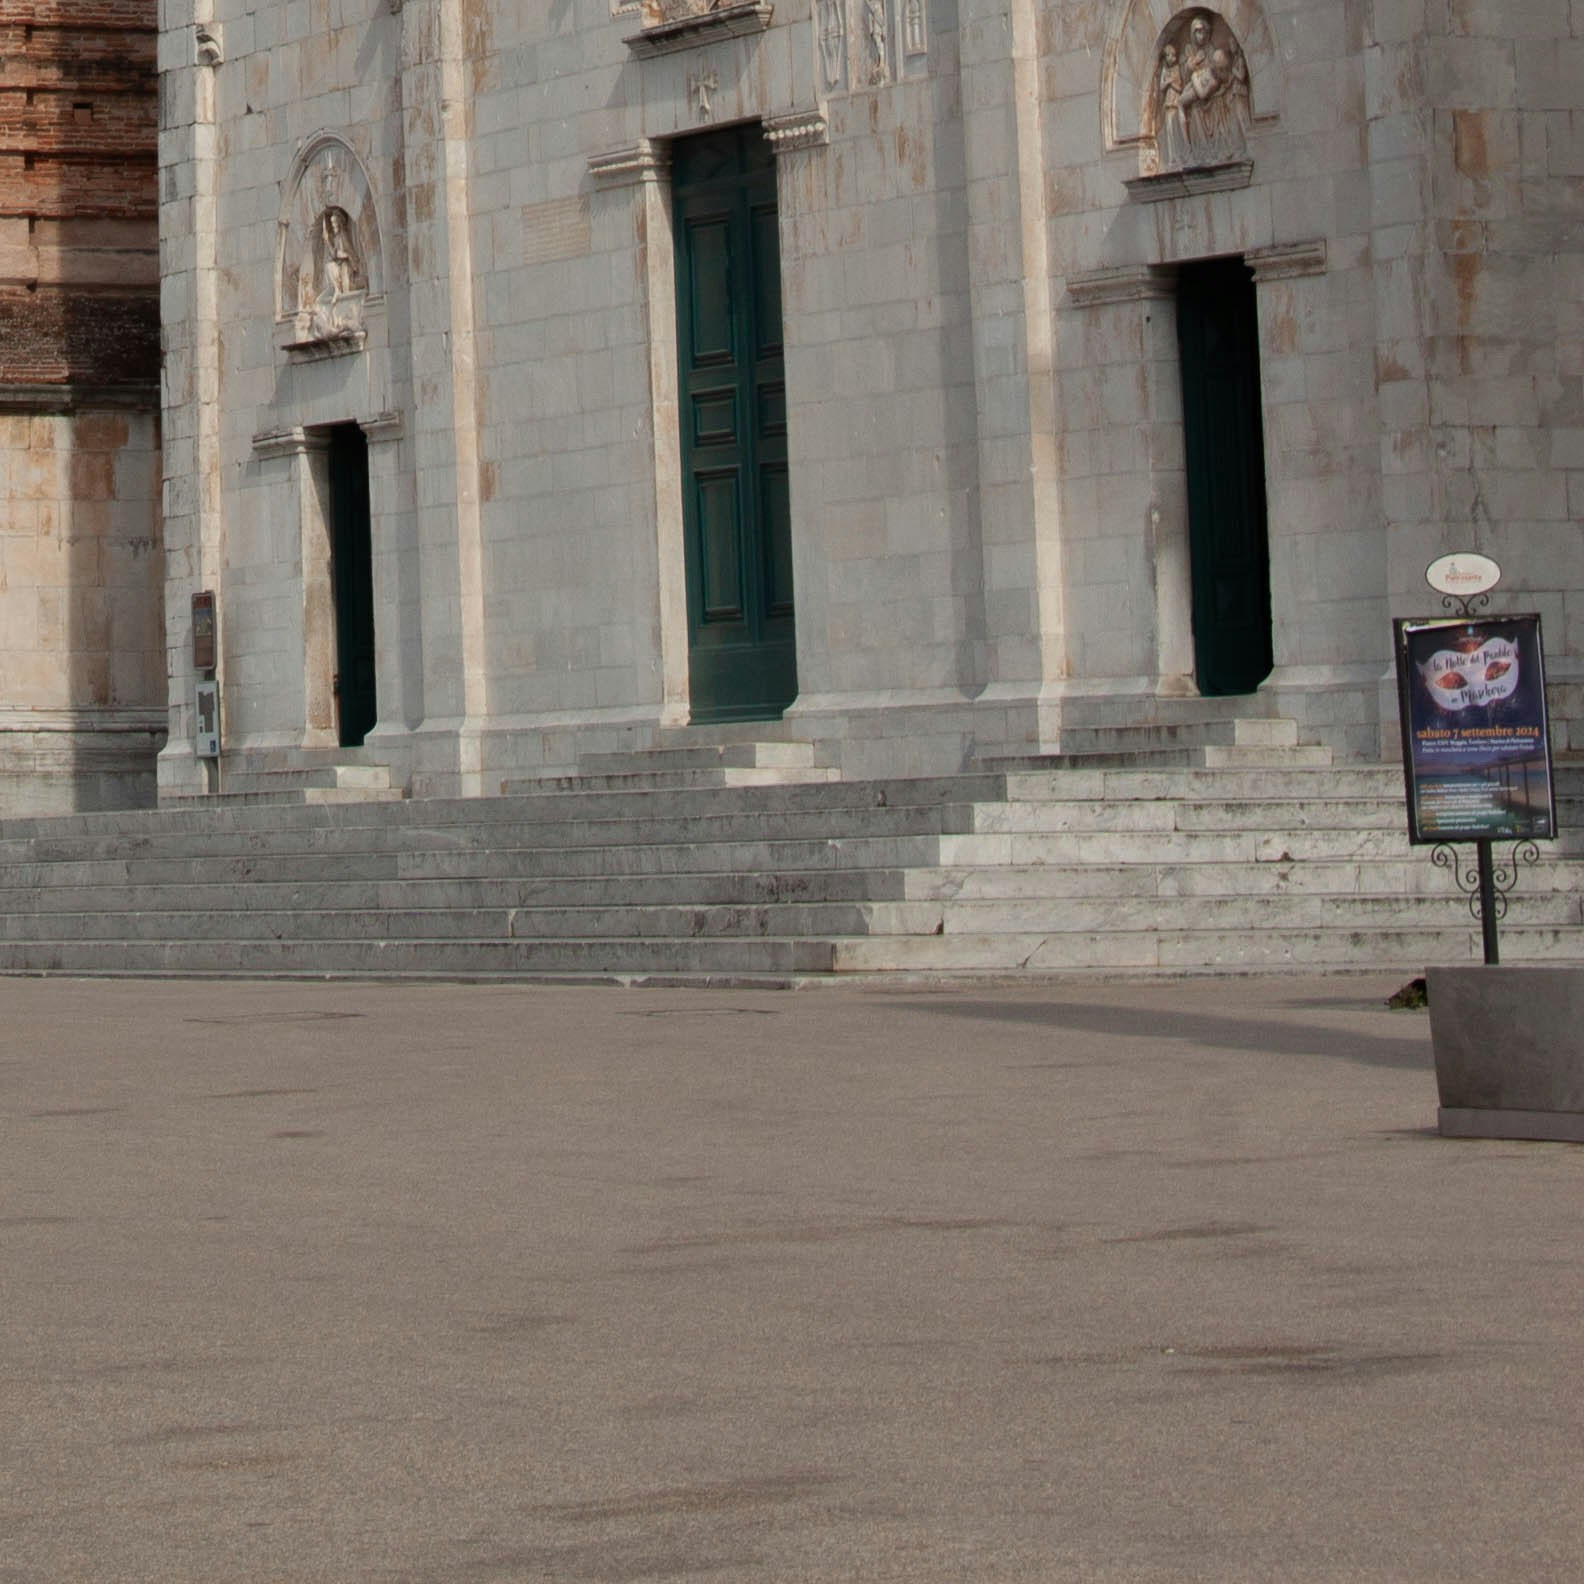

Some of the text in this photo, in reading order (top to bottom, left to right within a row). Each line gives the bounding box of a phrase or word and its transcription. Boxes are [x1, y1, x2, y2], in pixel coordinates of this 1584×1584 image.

[1416, 726, 1451, 738] sabato
[1453, 727, 1458, 739] 7
[1460, 724, 1513, 737] settembre
